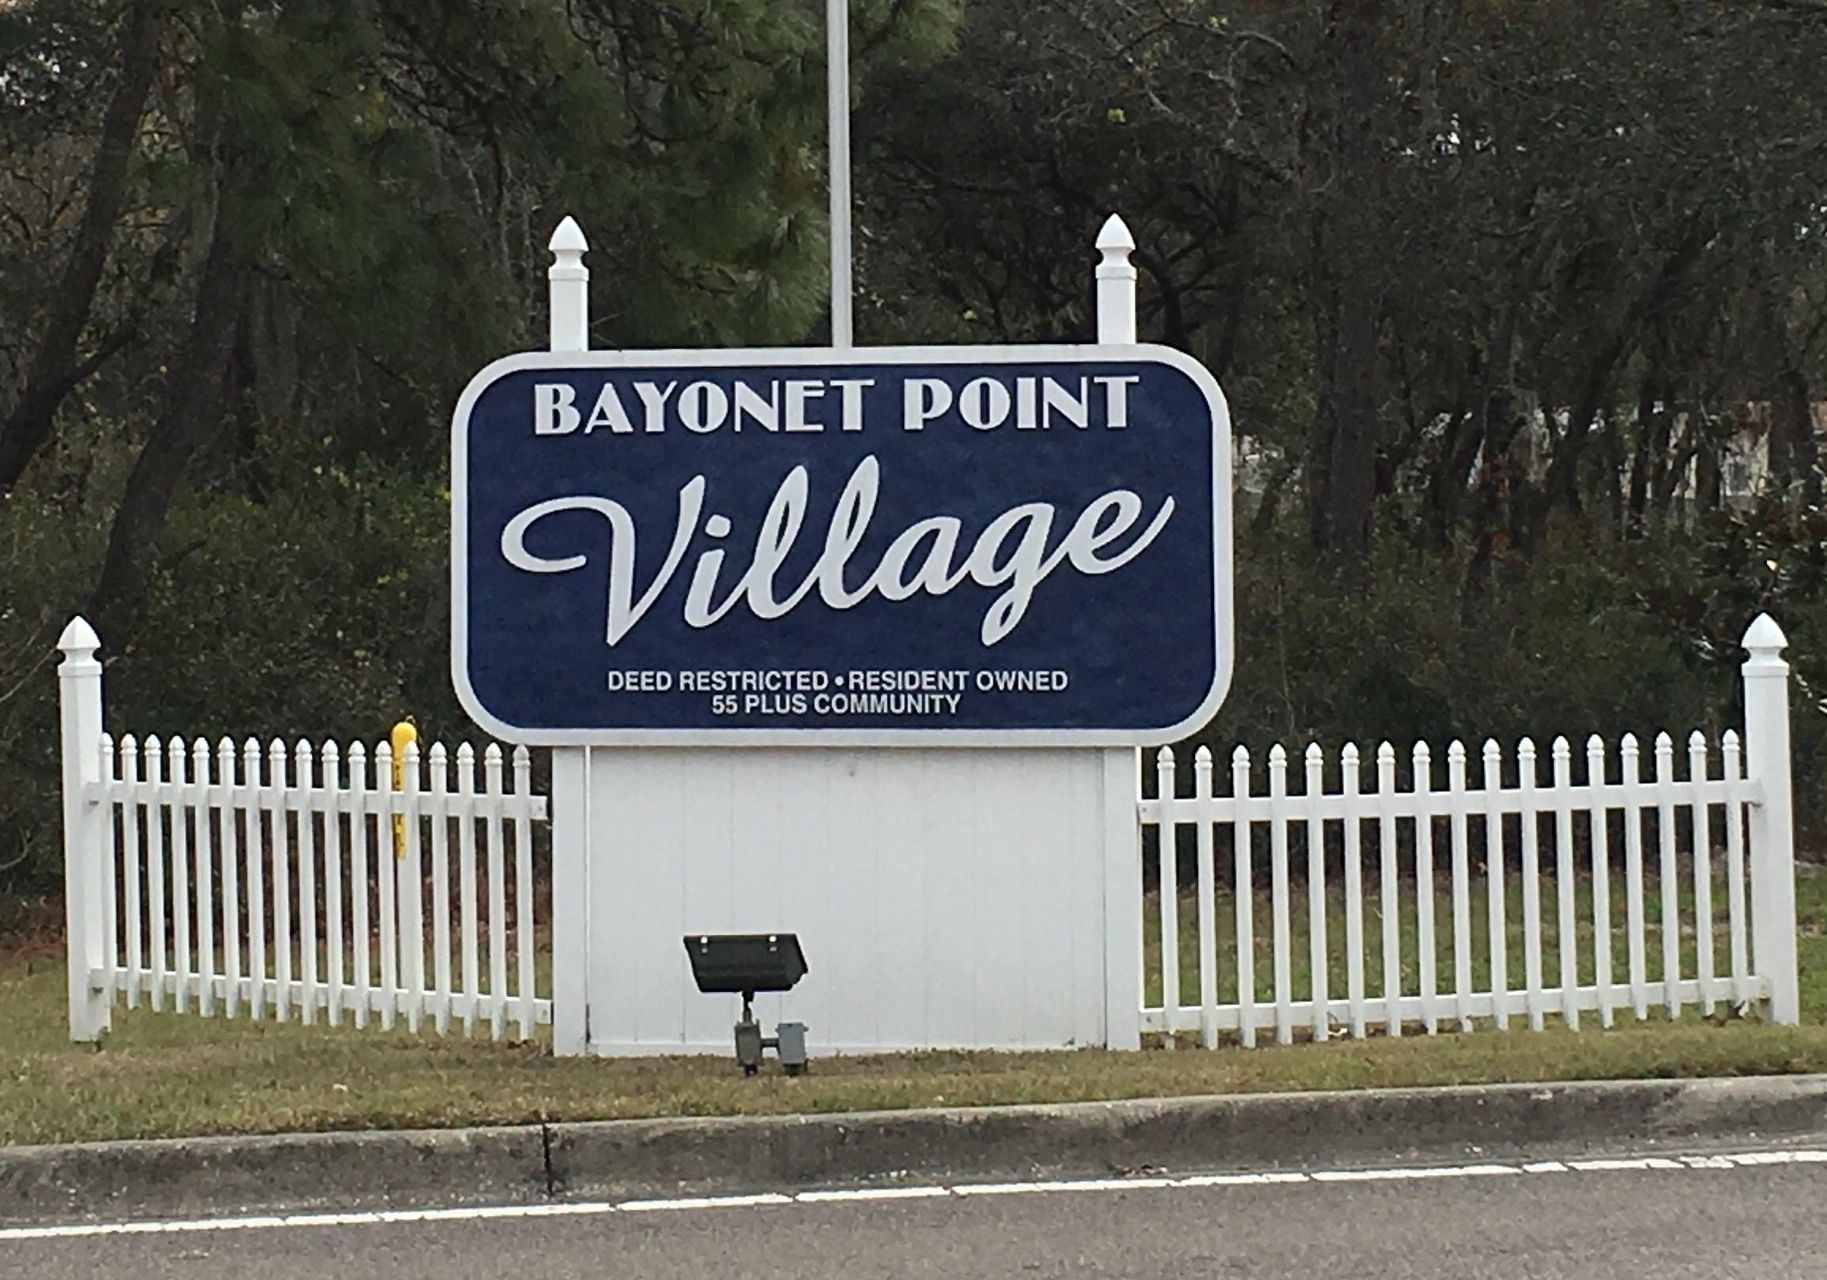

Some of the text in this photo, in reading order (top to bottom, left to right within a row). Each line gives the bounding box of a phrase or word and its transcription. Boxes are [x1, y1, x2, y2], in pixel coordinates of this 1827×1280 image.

[534, 375, 1140, 435] BAYONET POINT
[501, 454, 1175, 647] Village
[608, 670, 1068, 691] DEED RESTRICTED RESIDENT OWNED
[712, 693, 961, 714] 55 PLUS COMMUNITY
